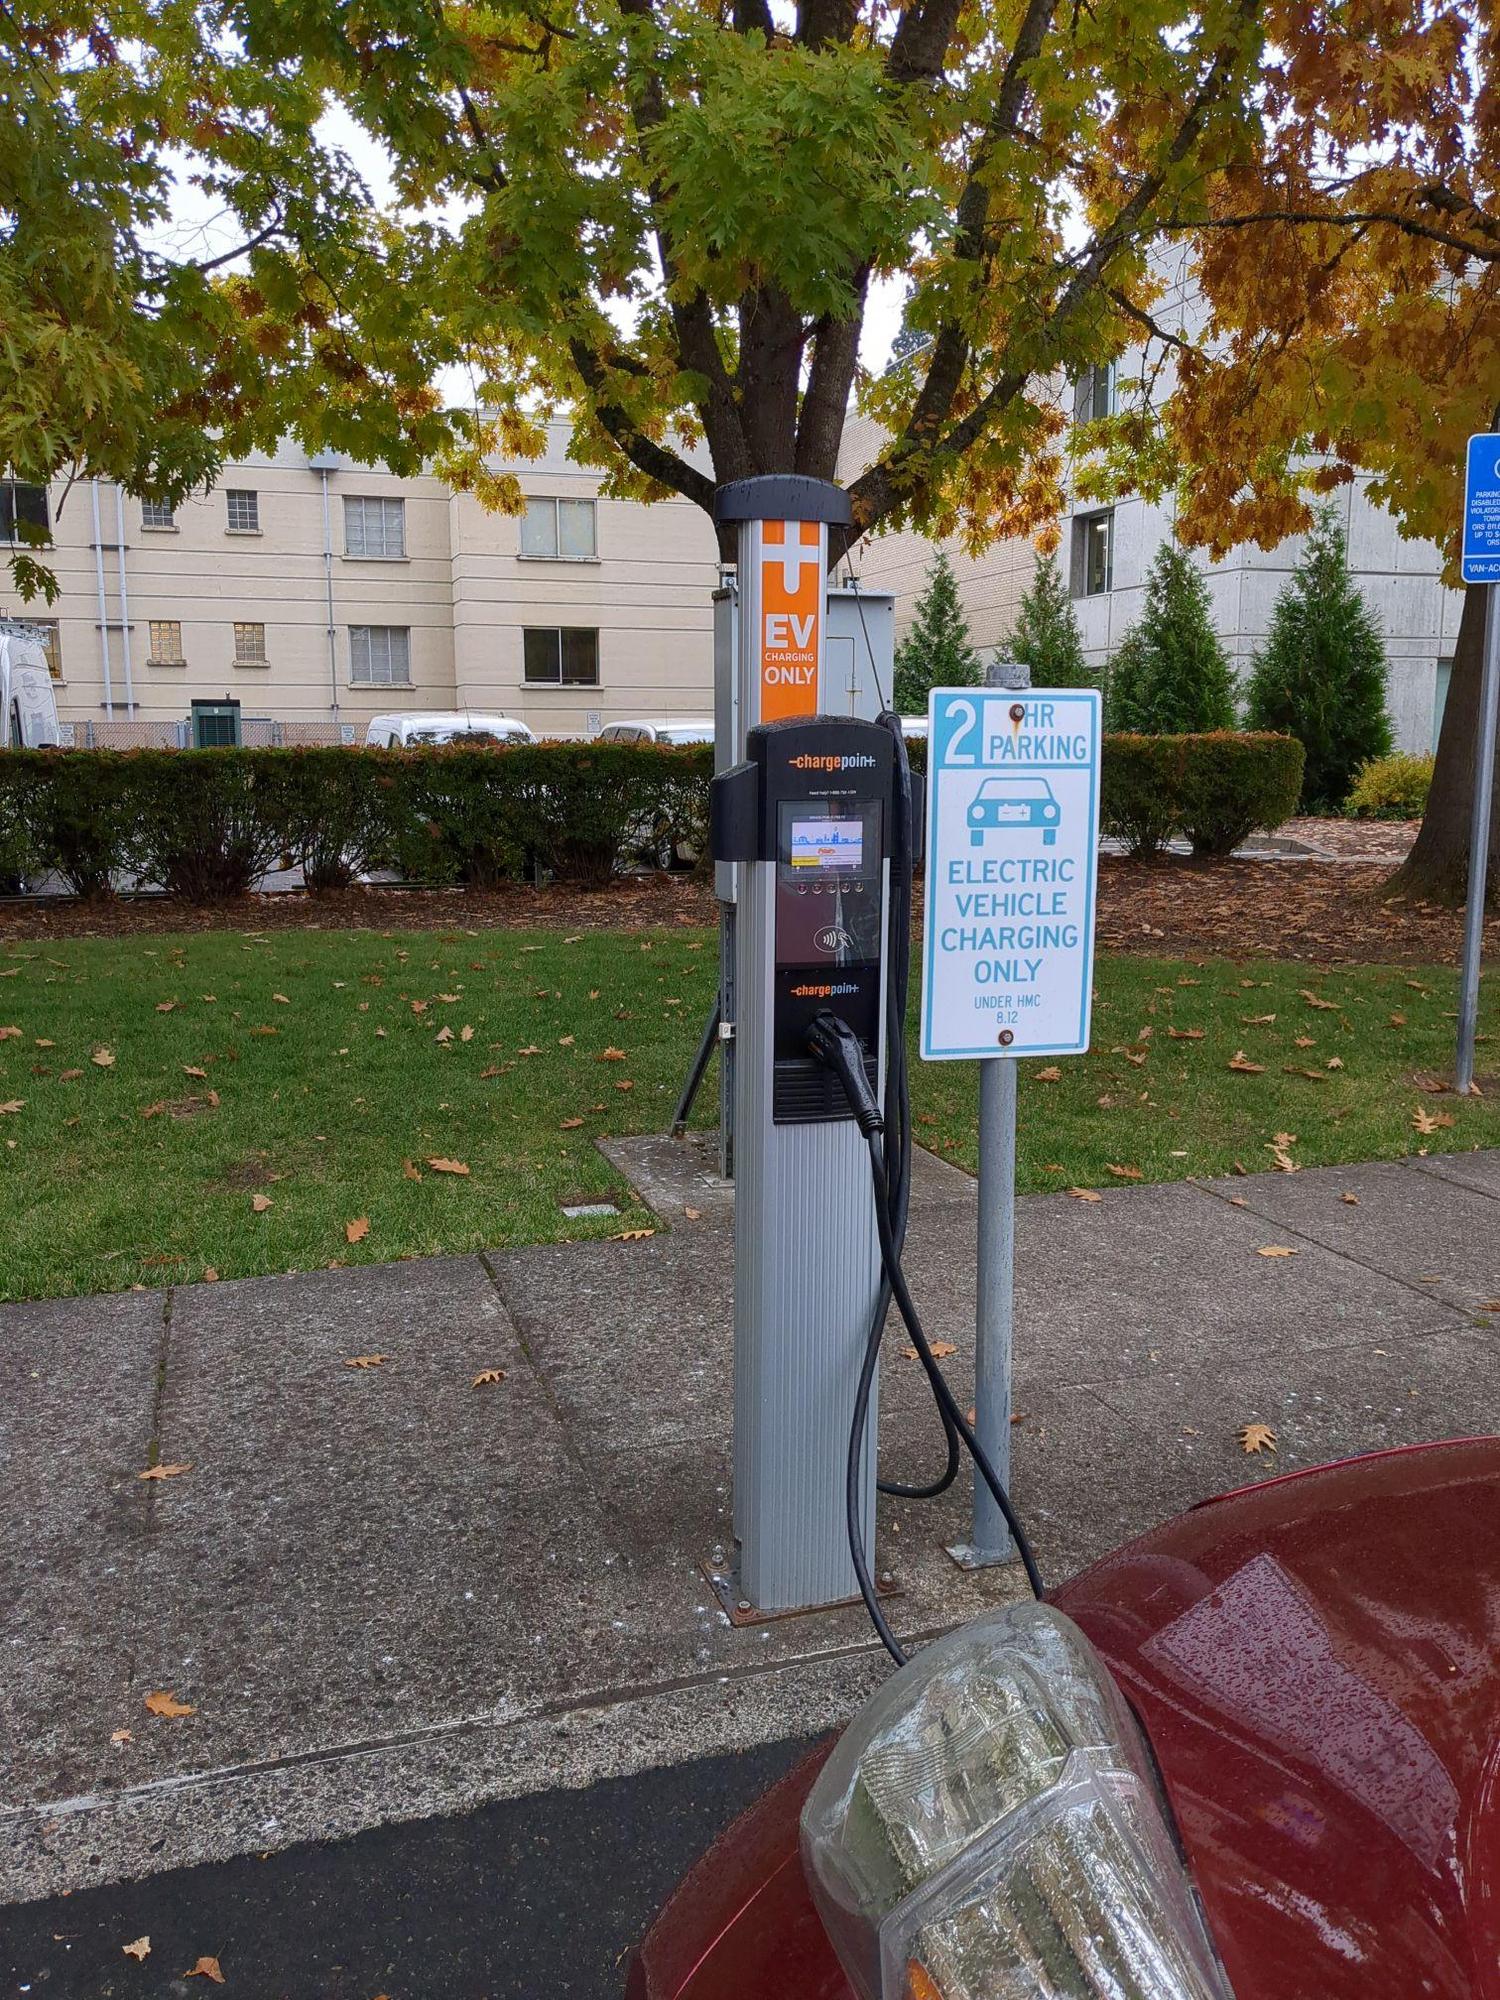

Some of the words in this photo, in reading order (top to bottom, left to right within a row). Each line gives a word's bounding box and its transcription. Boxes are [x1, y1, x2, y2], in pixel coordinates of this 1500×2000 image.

[765, 613, 816, 649] EV
[765, 652, 814, 662] CHARGING
[764, 666, 815, 685] ONLY
[944, 699, 976, 765] 2
[1023, 703, 1055, 728] HR
[989, 735, 1087, 761] PARKING
[948, 858, 1076, 884] ELECTRIC
[955, 892, 1067, 917] VEHICLE
[940, 924, 1078, 951] CHARGING
[974, 958, 1043, 983] ONLY
[974, 995, 1012, 1009] UNDER
[1017, 994, 1041, 1008] HMC
[996, 1011, 1019, 1024] 8.12
